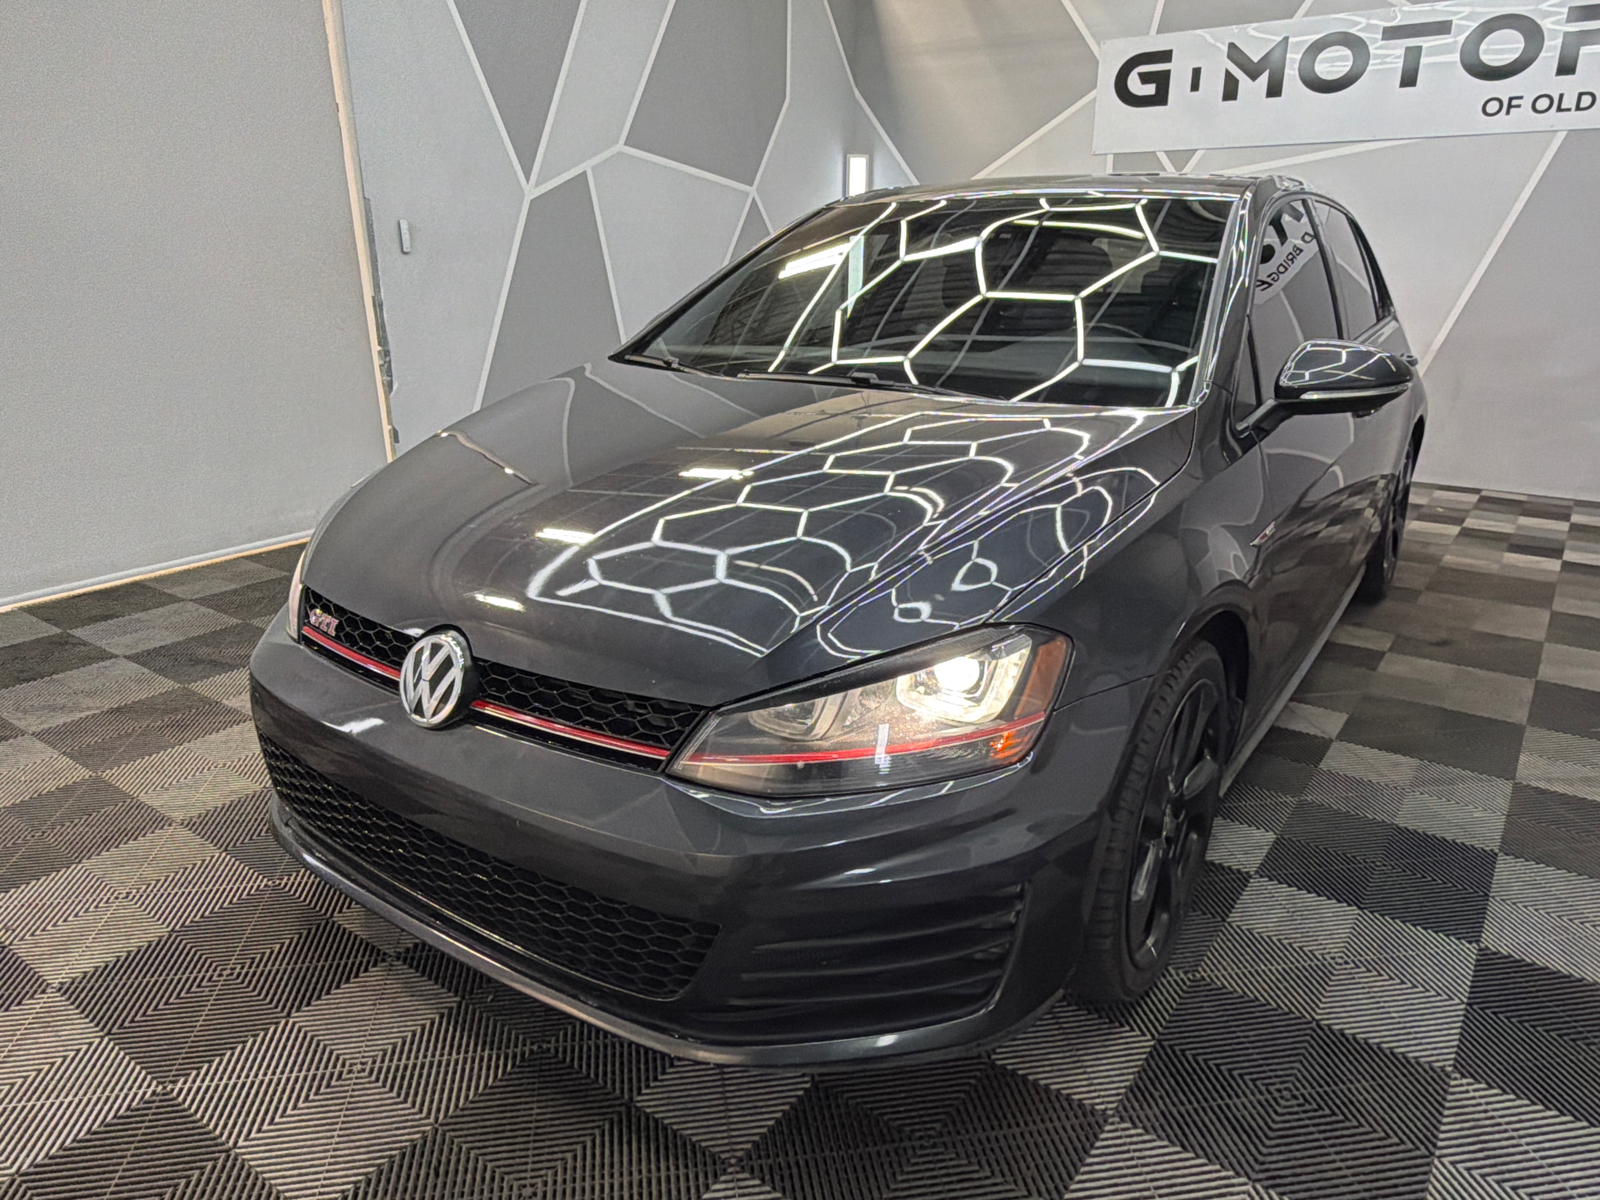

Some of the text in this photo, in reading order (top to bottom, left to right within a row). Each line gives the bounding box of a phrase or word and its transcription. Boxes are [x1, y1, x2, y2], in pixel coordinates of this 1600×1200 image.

[1481, 90, 1597, 117] OF OLD
[309, 608, 340, 637] GTI
